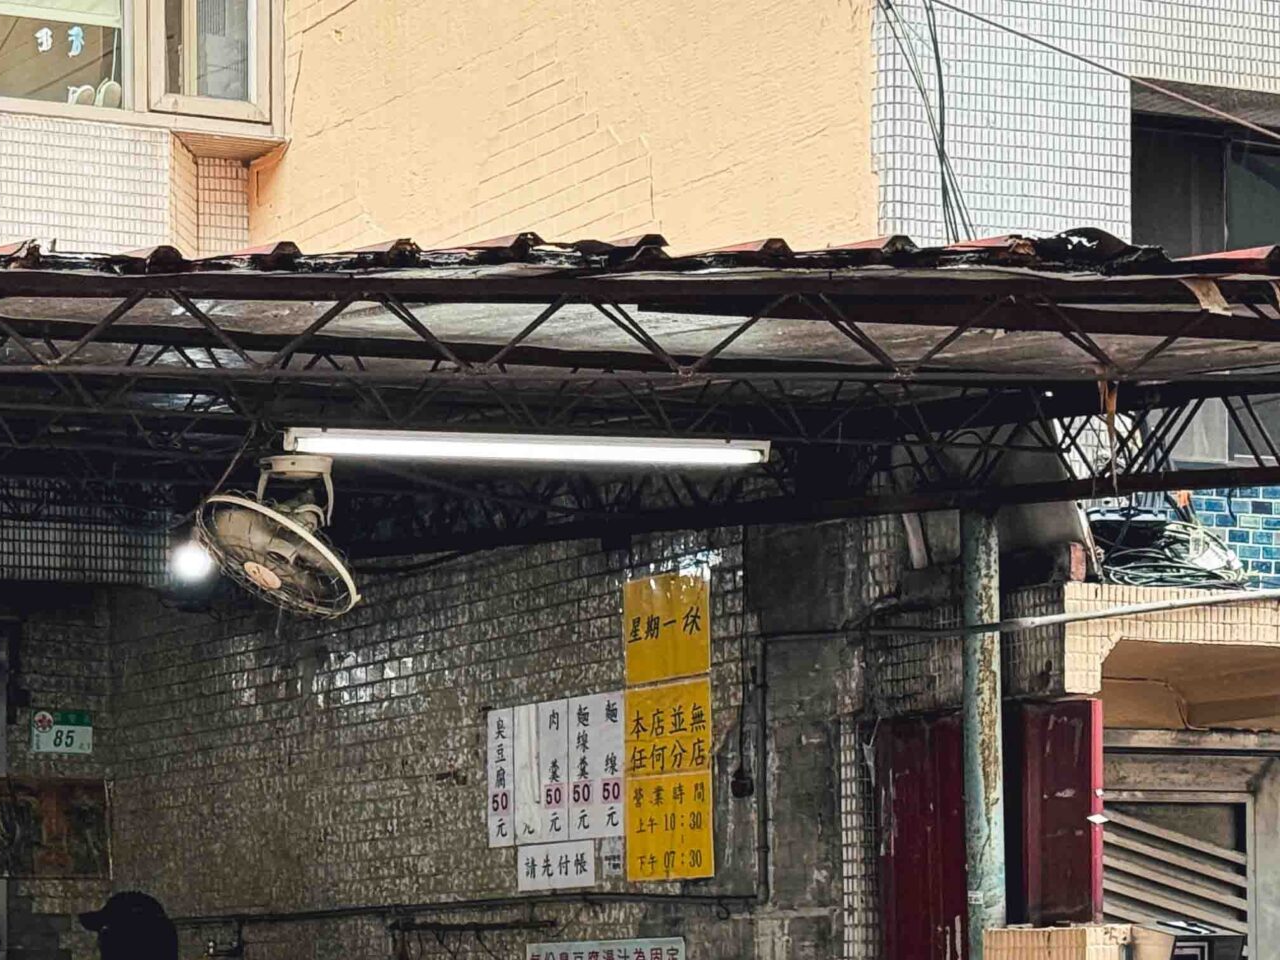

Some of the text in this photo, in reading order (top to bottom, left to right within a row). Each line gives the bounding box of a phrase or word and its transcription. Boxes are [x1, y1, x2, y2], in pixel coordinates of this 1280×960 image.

[627, 606, 702, 644] 星期一休
[630, 703, 707, 741] 本店並無
[53, 729, 76, 748] 85
[630, 738, 706, 772] 任何分店
[633, 781, 705, 808] 營業時間
[635, 811, 702, 834] 上午 10:30
[524, 852, 588, 880] 請先付帳
[636, 853, 657, 871] 下午
[663, 849, 702, 869] 07:30
